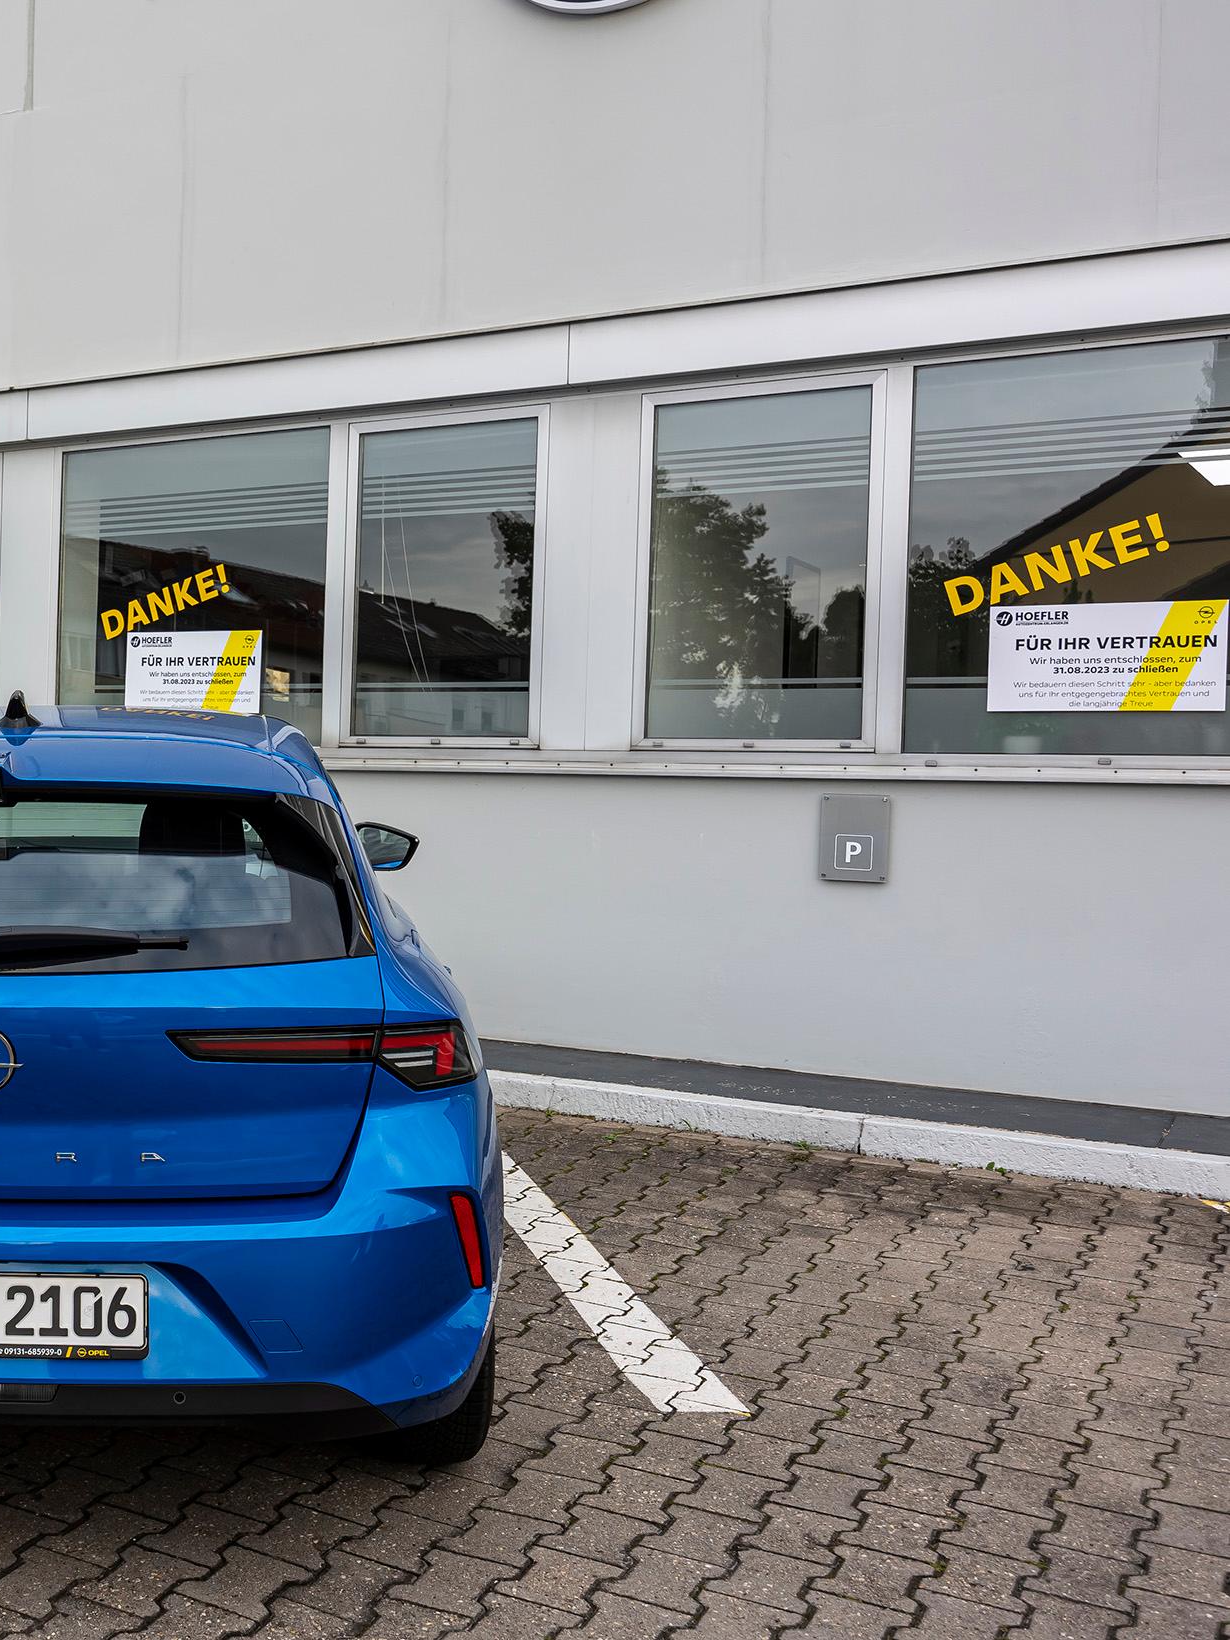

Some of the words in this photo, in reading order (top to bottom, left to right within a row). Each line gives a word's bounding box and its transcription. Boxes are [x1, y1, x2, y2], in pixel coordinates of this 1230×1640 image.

[943, 512, 1170, 617] DANKE!
[100, 564, 230, 640] DANKE!
[1016, 611, 1068, 621] HOEFLER
[1016, 634, 1052, 651] FÜR
[1058, 638, 1090, 650] IHR
[1096, 635, 1217, 649] VERTRAUEN
[141, 654, 162, 666] FÜR
[166, 656, 184, 666] IHR
[188, 656, 256, 666] VERTRAUEN
[1104, 656, 1176, 664] entschlossen,
[1128, 665, 1178, 673] schließen
[1061, 690, 1146, 699] entgegengebrachtes
[1083, 700, 1127, 708] langjährige
[845, 841, 862, 863] P
[5, 1285, 136, 1337] 2106
